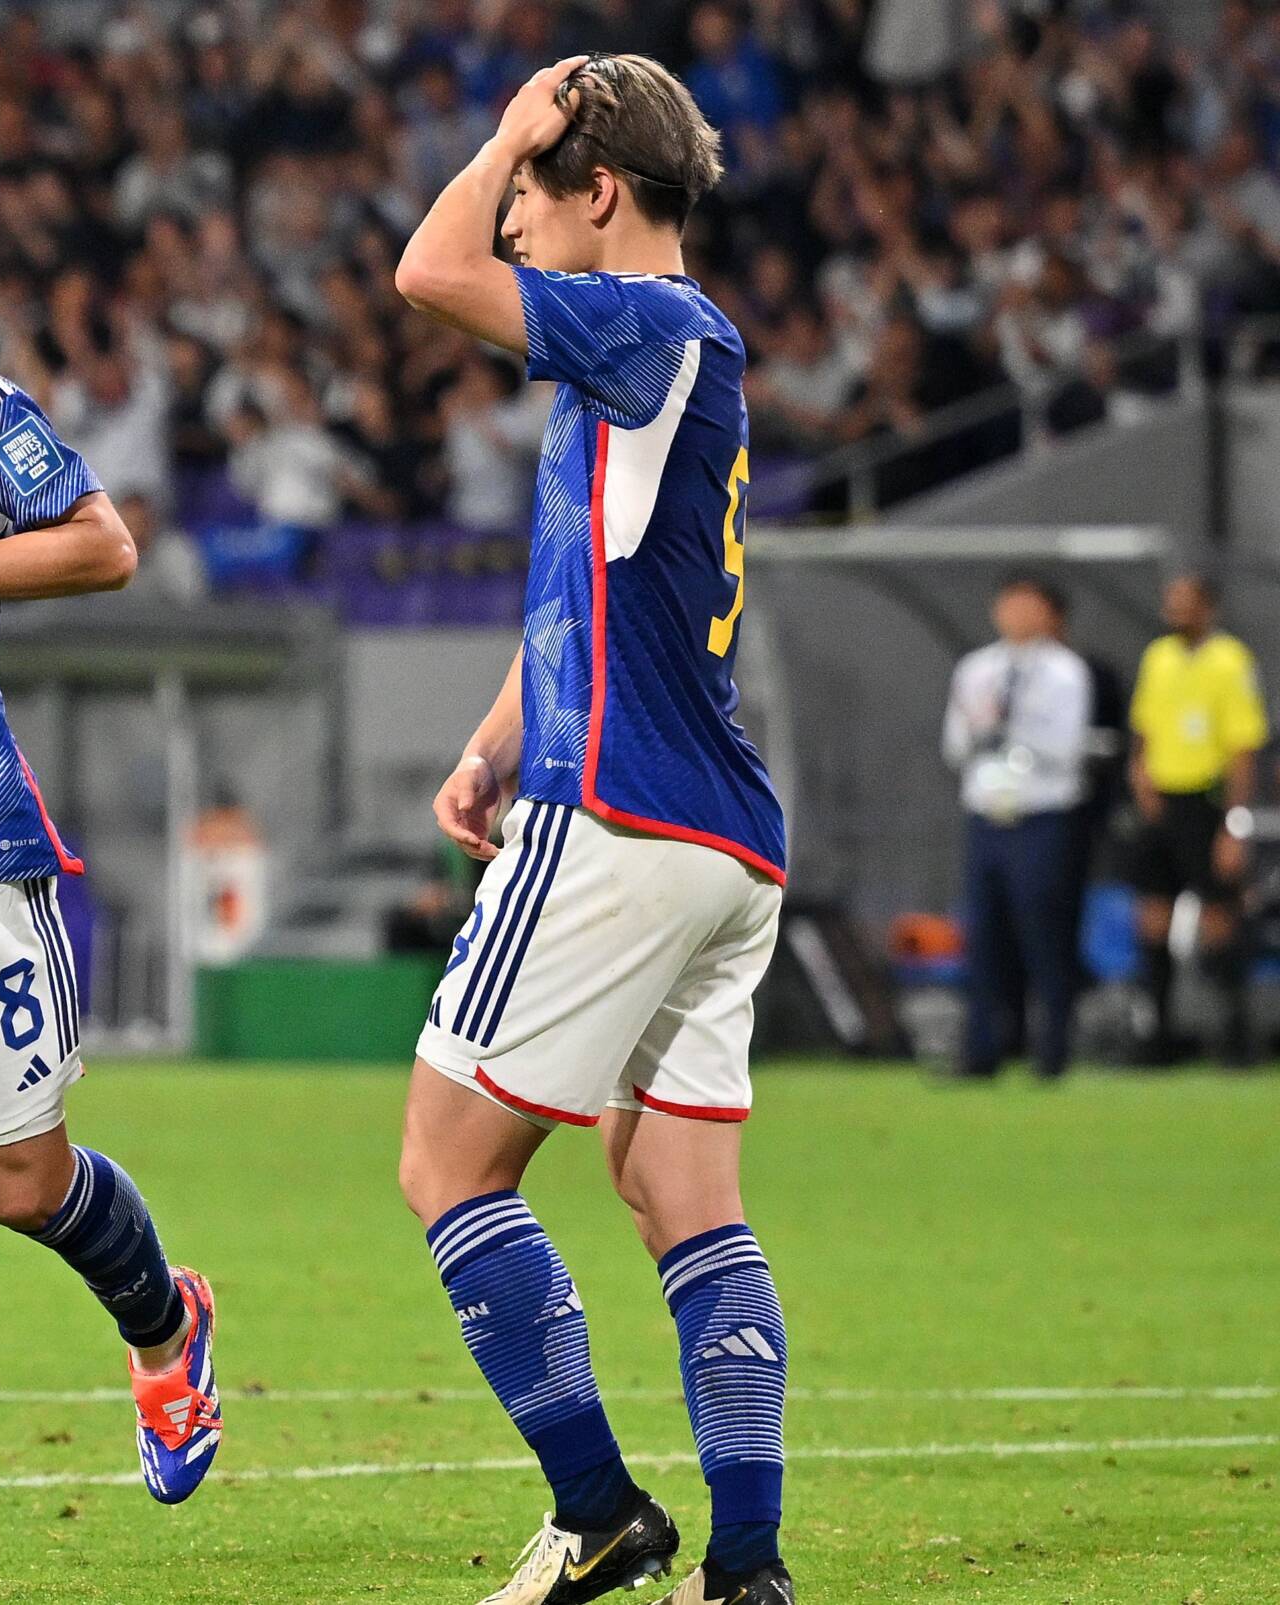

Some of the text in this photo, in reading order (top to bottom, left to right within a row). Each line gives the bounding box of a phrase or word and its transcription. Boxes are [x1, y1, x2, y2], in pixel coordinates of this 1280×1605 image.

[3, 428, 35, 454] FOOTBALL
[7, 436, 41, 464] UNITES
[14, 445, 49, 475] the World
